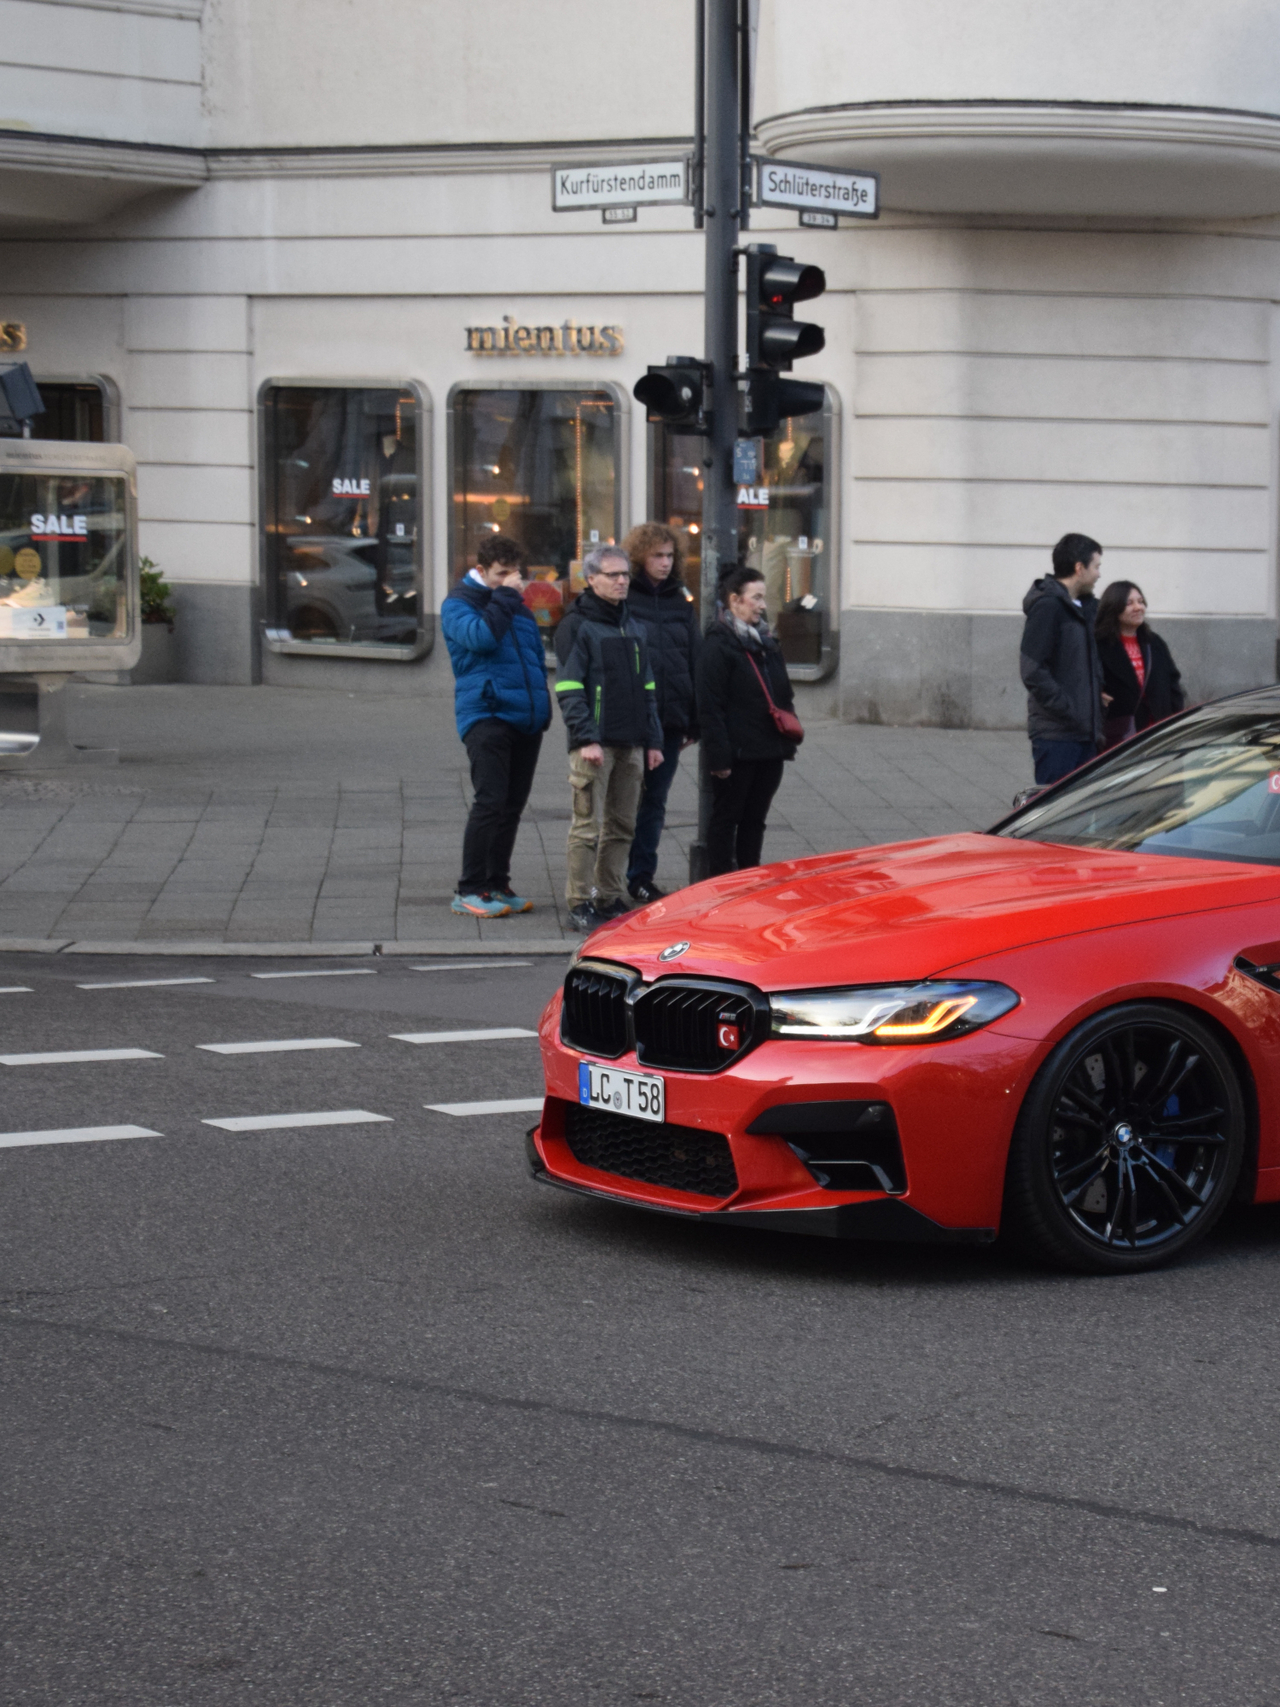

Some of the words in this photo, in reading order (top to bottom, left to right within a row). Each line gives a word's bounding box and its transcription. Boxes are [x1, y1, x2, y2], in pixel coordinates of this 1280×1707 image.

[560, 169, 681, 195] Kurfürstendamm
[768, 170, 868, 207] Schlüterstraße
[464, 315, 625, 357] mientus
[332, 477, 371, 494] SALE
[737, 487, 770, 503] ALE
[30, 513, 88, 535] SALE
[589, 1070, 611, 1104] LC
